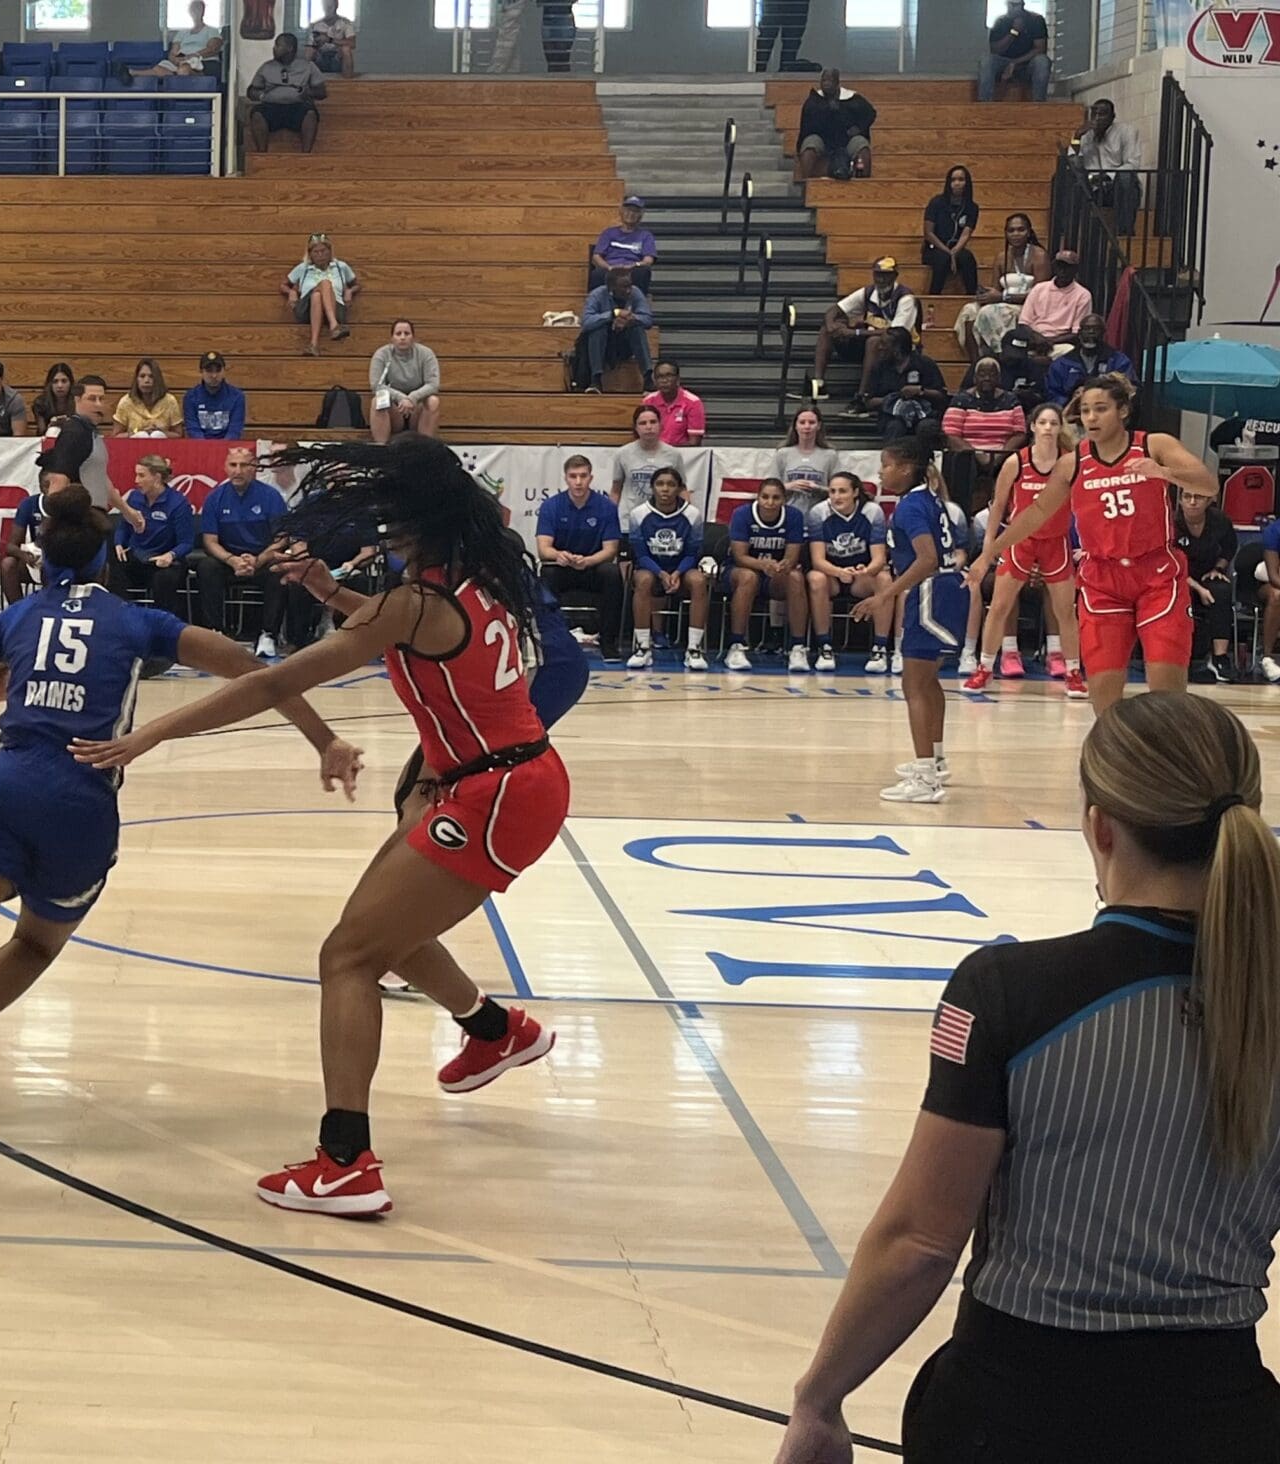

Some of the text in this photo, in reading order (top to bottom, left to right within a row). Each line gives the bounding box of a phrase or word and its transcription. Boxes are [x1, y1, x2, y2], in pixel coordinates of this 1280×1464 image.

[1082, 473, 1148, 490] GEORGIA
[1100, 489, 1136, 519] 35
[940, 512, 953, 548] 3
[33, 617, 94, 674] 15
[23, 680, 87, 712] BAINES
